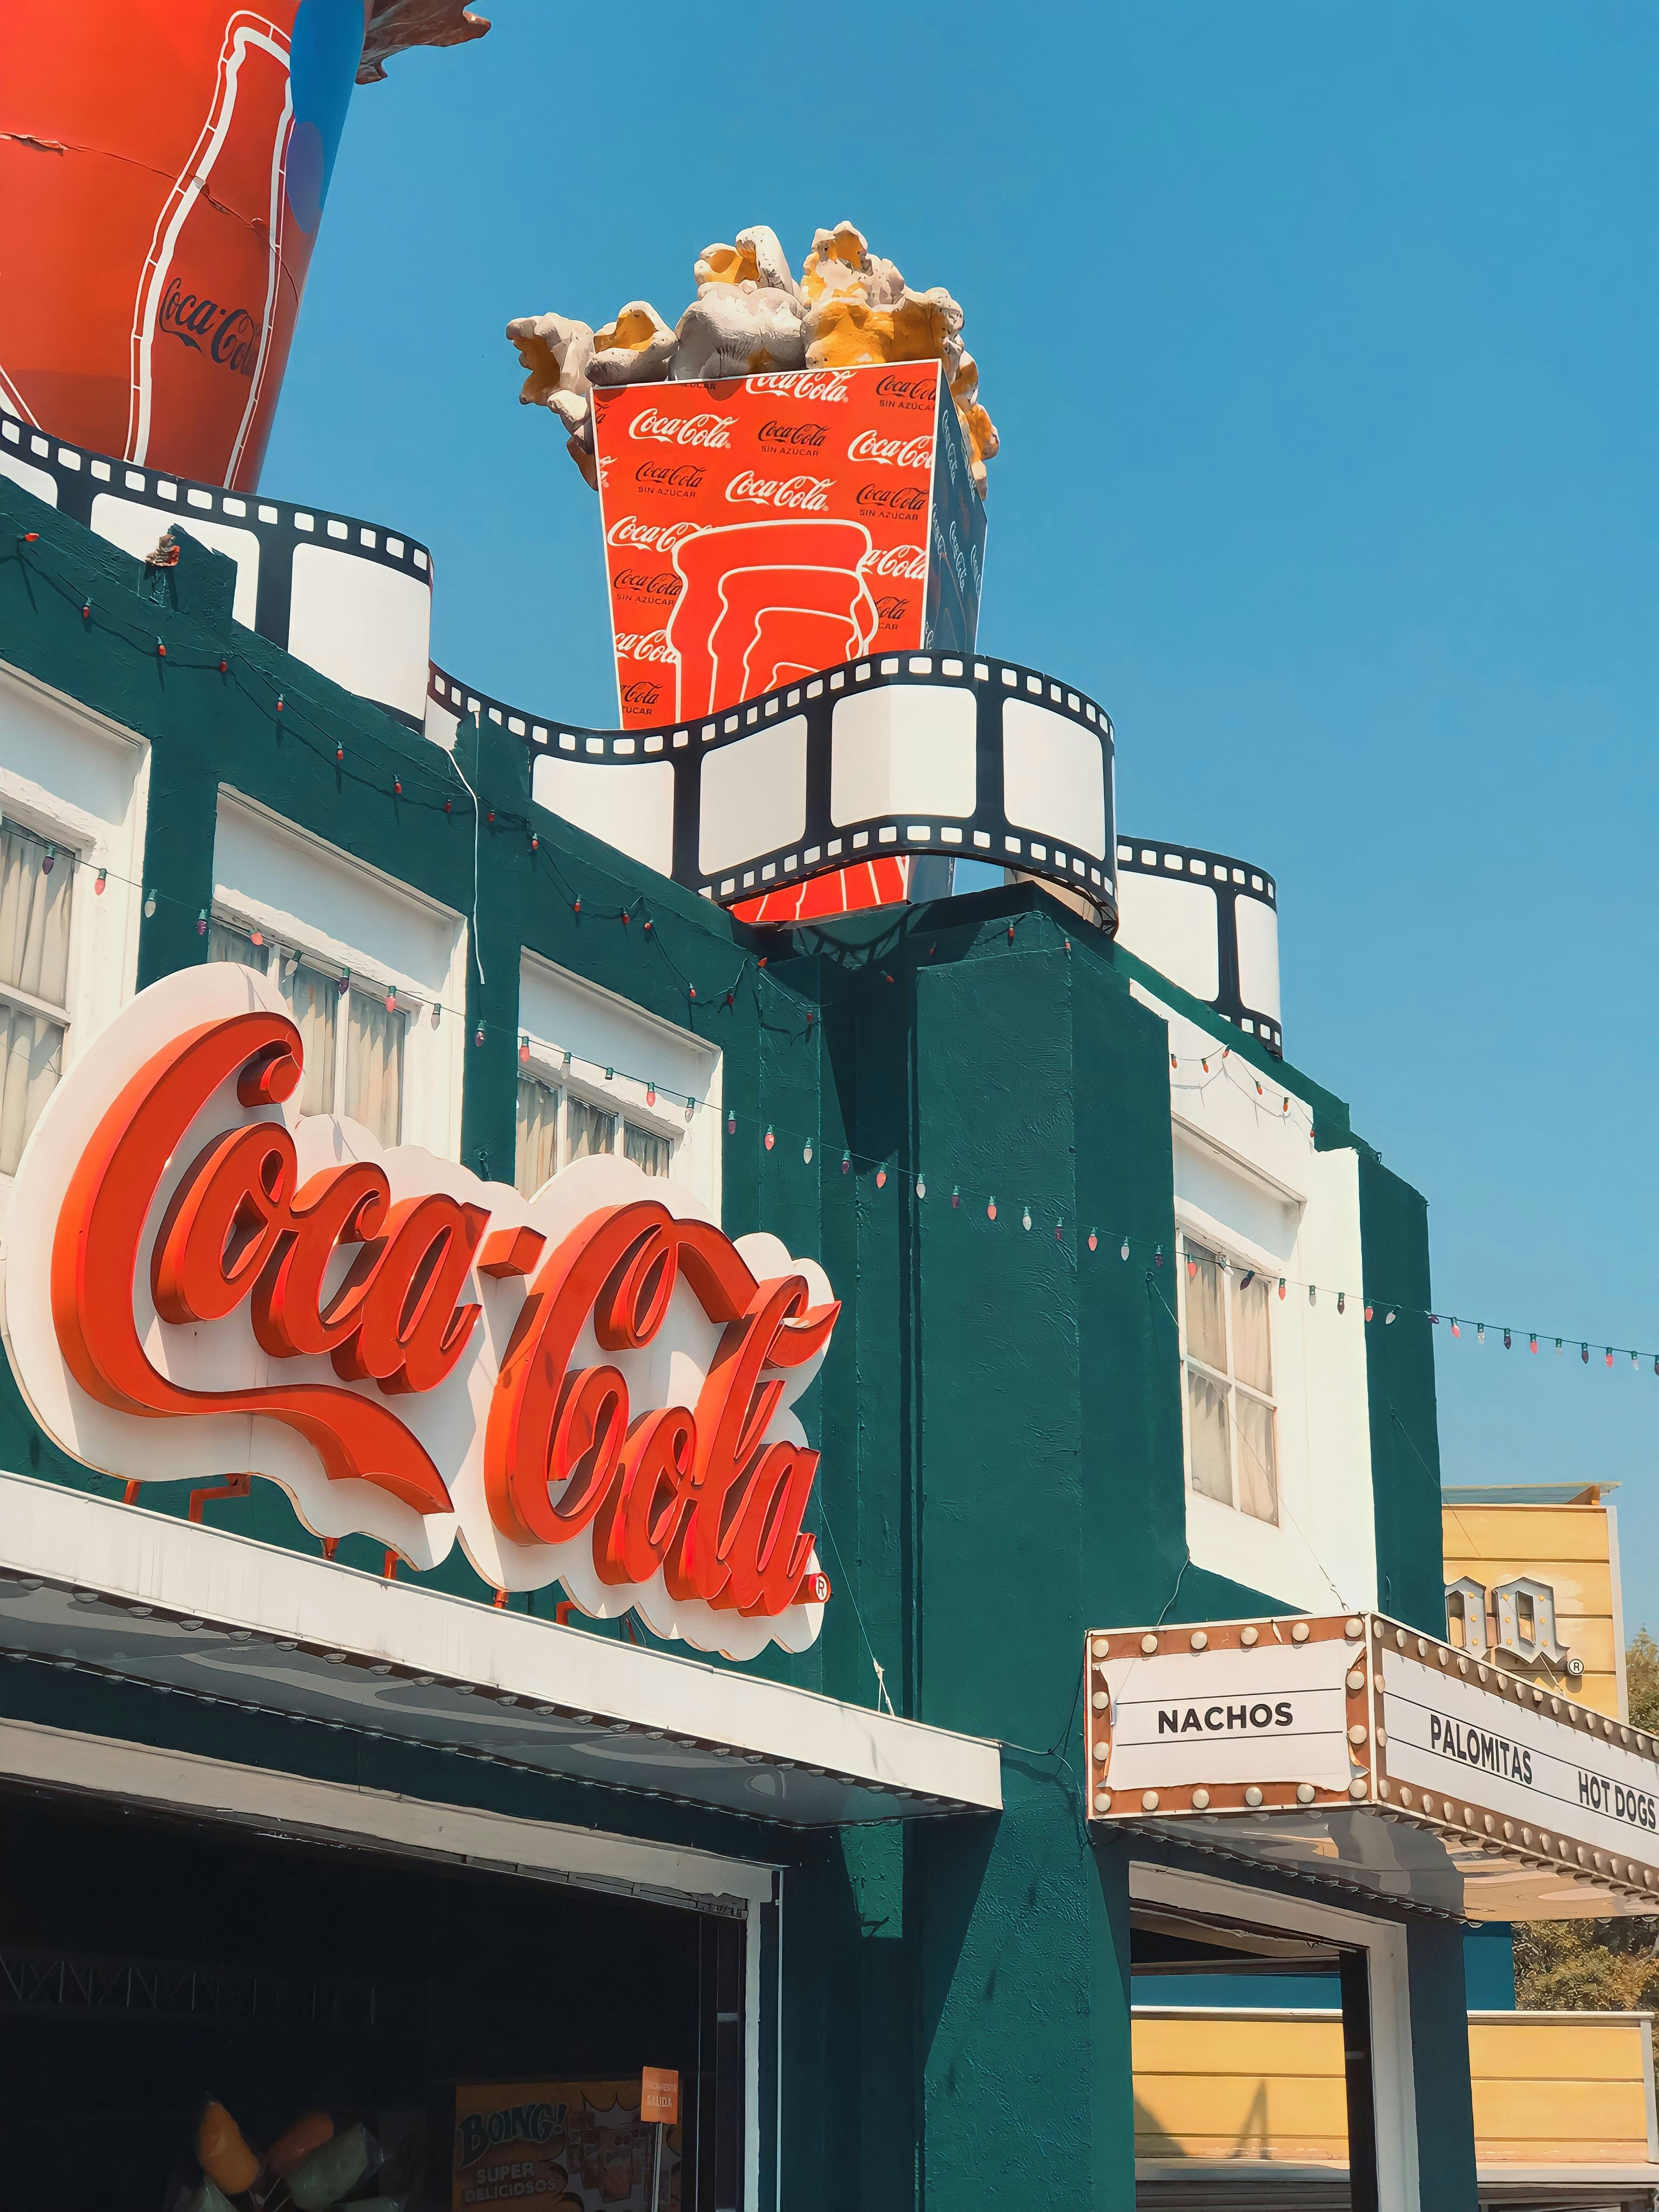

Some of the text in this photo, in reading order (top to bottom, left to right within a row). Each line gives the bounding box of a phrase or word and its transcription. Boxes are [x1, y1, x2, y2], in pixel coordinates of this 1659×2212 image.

[629, 408, 739, 448] Coca-Cola
[758, 420, 832, 447] Coca-Cola
[635, 461, 708, 488] Coca-Cola
[638, 485, 655, 494] SIN
[725, 470, 837, 511] Coca-Cola
[856, 483, 930, 510] Coca-Cola
[51, 1011, 841, 1617] Coca-Cola
[1158, 1702, 1293, 1734] NACHOS
[1430, 1713, 1533, 1785] PALOMITAS
[1578, 1771, 1656, 1830] HOT DOGS
[458, 2102, 568, 2170] BOING!
[476, 2161, 536, 2184] SUPER
[463, 2178, 557, 2204] DELICIOSOS
